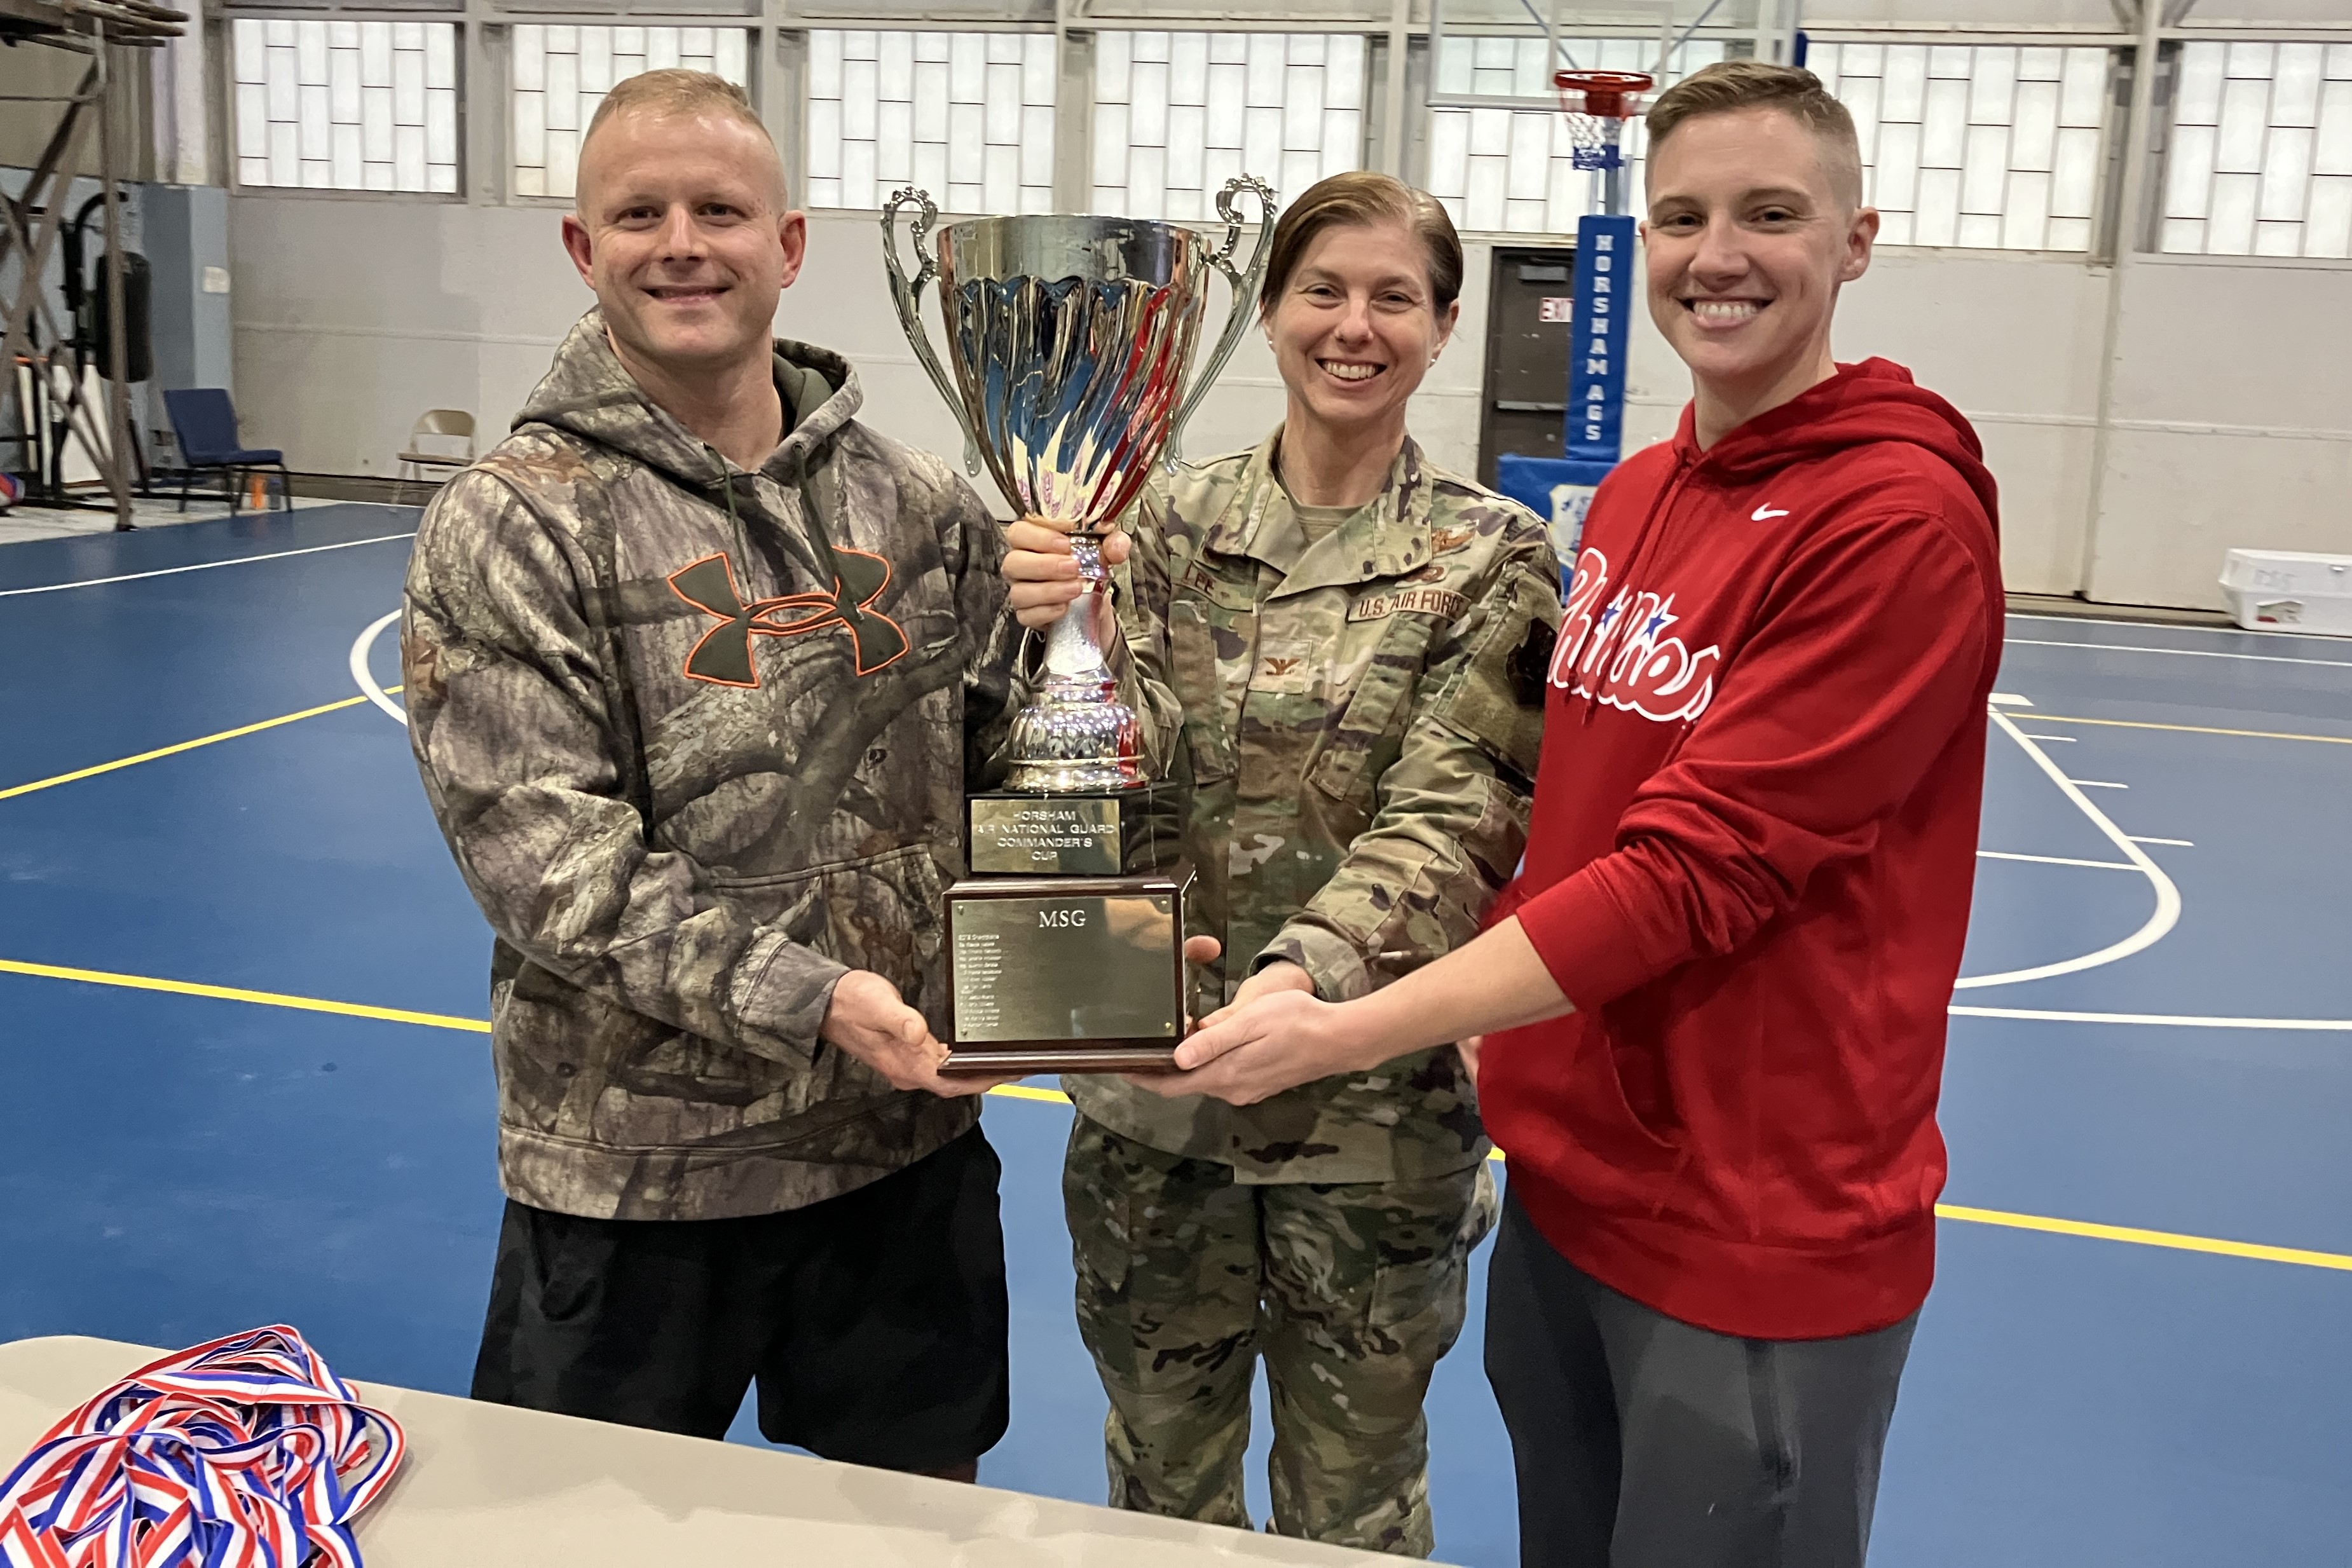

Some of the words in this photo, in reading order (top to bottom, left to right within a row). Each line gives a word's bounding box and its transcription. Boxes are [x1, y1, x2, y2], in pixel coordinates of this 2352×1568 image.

[1586, 235, 1614, 375] HORSHAM
[1585, 385, 1604, 441] AGS
[1359, 598, 1386, 617] U.S.
[1390, 590, 1417, 611] AIR
[1013, 811, 1076, 821] HORSHAM
[977, 824, 995, 834] AIR
[1002, 824, 1064, 834] NATIONAL
[1070, 824, 1115, 834] GUARD
[997, 837, 1093, 848] COMMANDER'S
[1031, 850, 1058, 861] CUP
[1039, 910, 1086, 928] MSG
